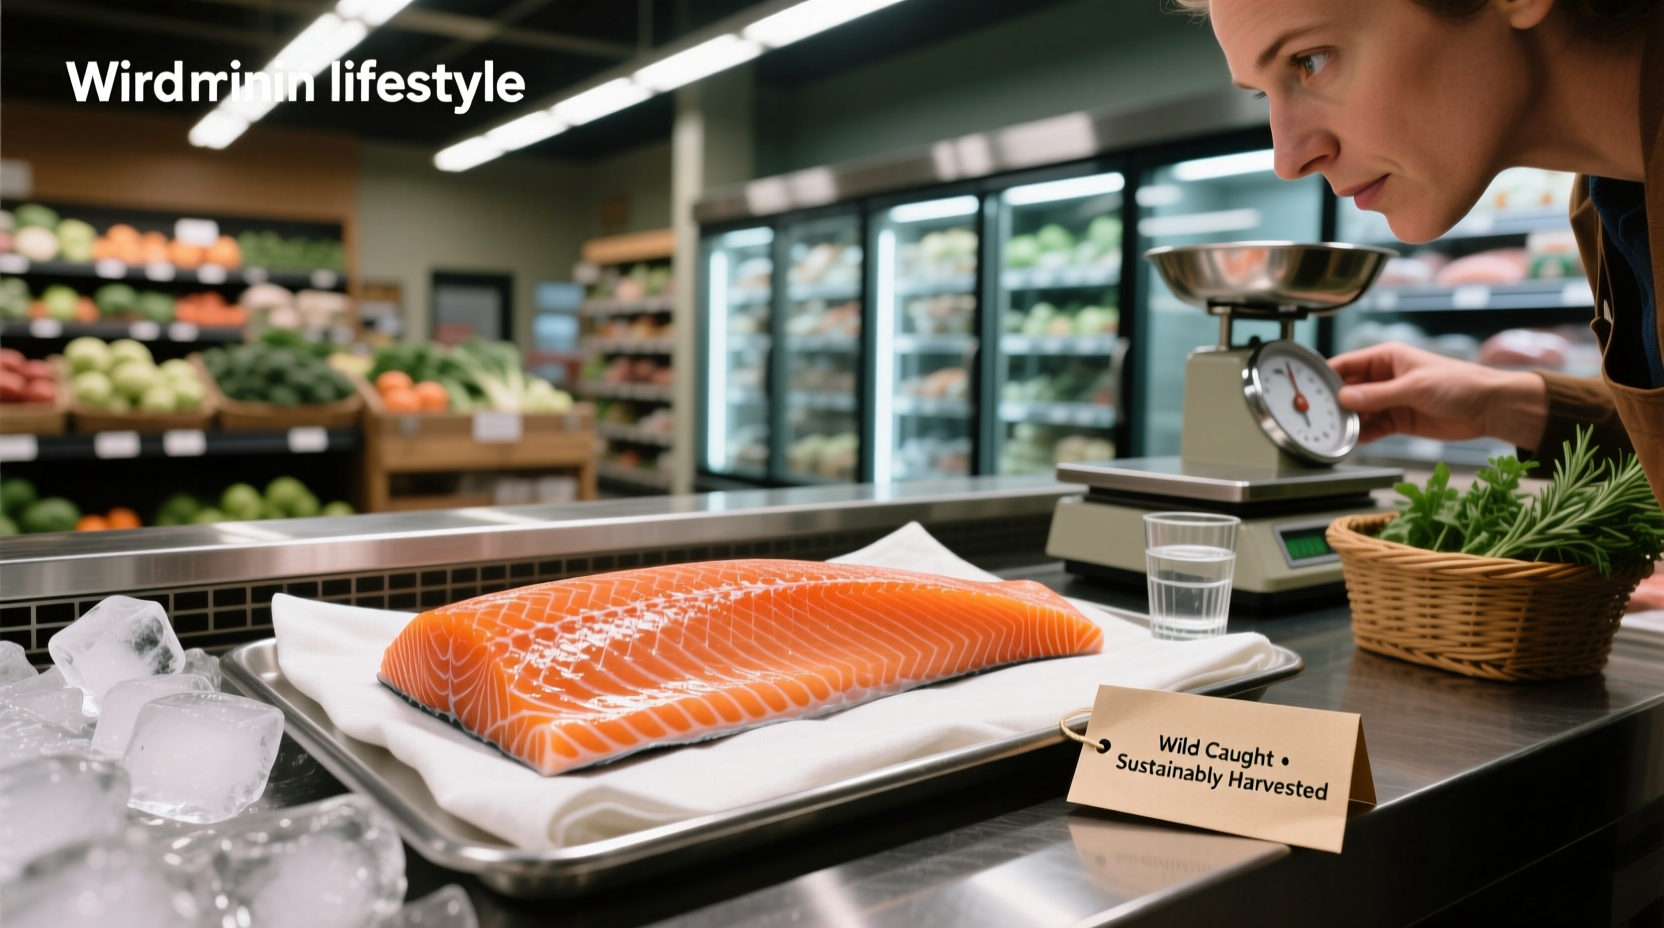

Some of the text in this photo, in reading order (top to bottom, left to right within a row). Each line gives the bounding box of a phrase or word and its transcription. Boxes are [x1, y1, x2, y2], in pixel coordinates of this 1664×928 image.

[1159, 734, 1201, 757] Wild
[1205, 741, 1275, 769] Caught
[1115, 753, 1329, 801] Sustainably Harvested
